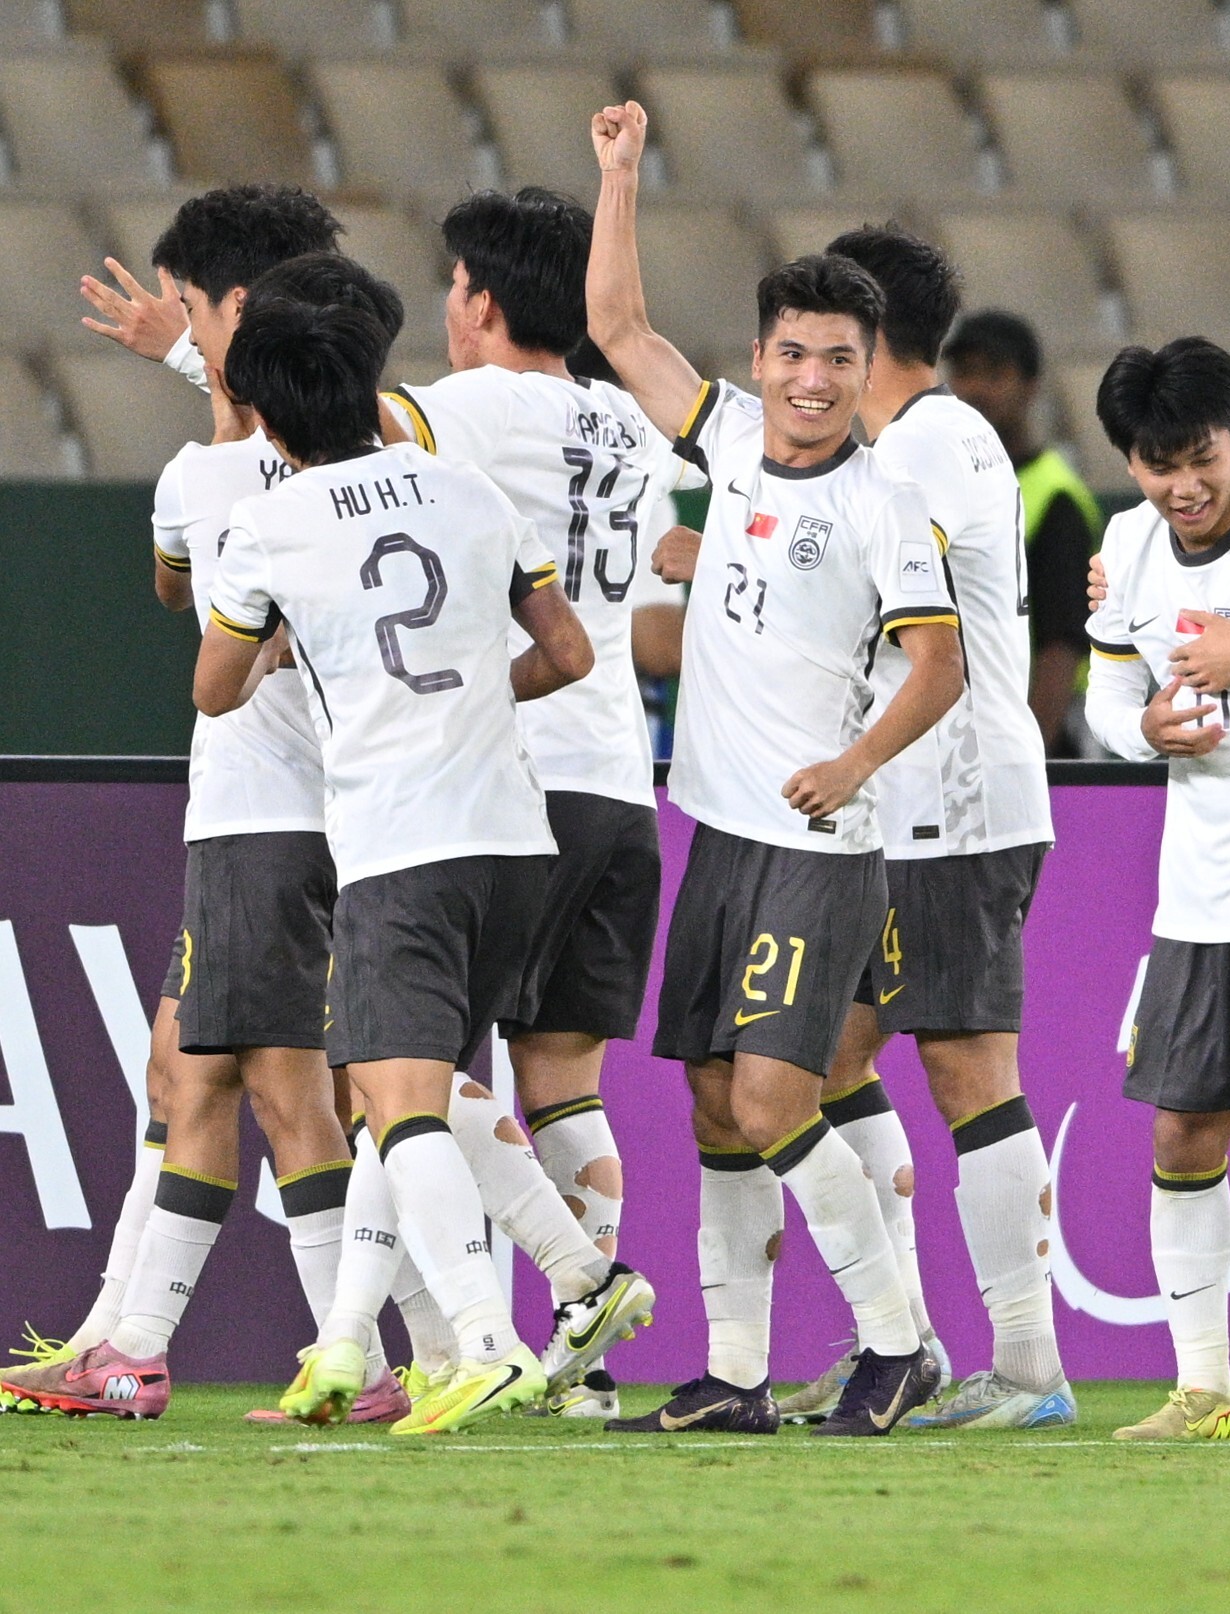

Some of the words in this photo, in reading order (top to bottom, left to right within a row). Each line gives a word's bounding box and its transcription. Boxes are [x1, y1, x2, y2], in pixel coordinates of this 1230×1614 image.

[330, 483, 371, 520] HU
[374, 473, 435, 510] H.T.
[561, 446, 649, 602] 13
[800, 519, 829, 535] CFA
[903, 560, 929, 573] AFC
[360, 532, 464, 695] 2
[724, 563, 767, 635] 21
[742, 933, 805, 1006] 21
[354, 1227, 396, 1250] 中国
